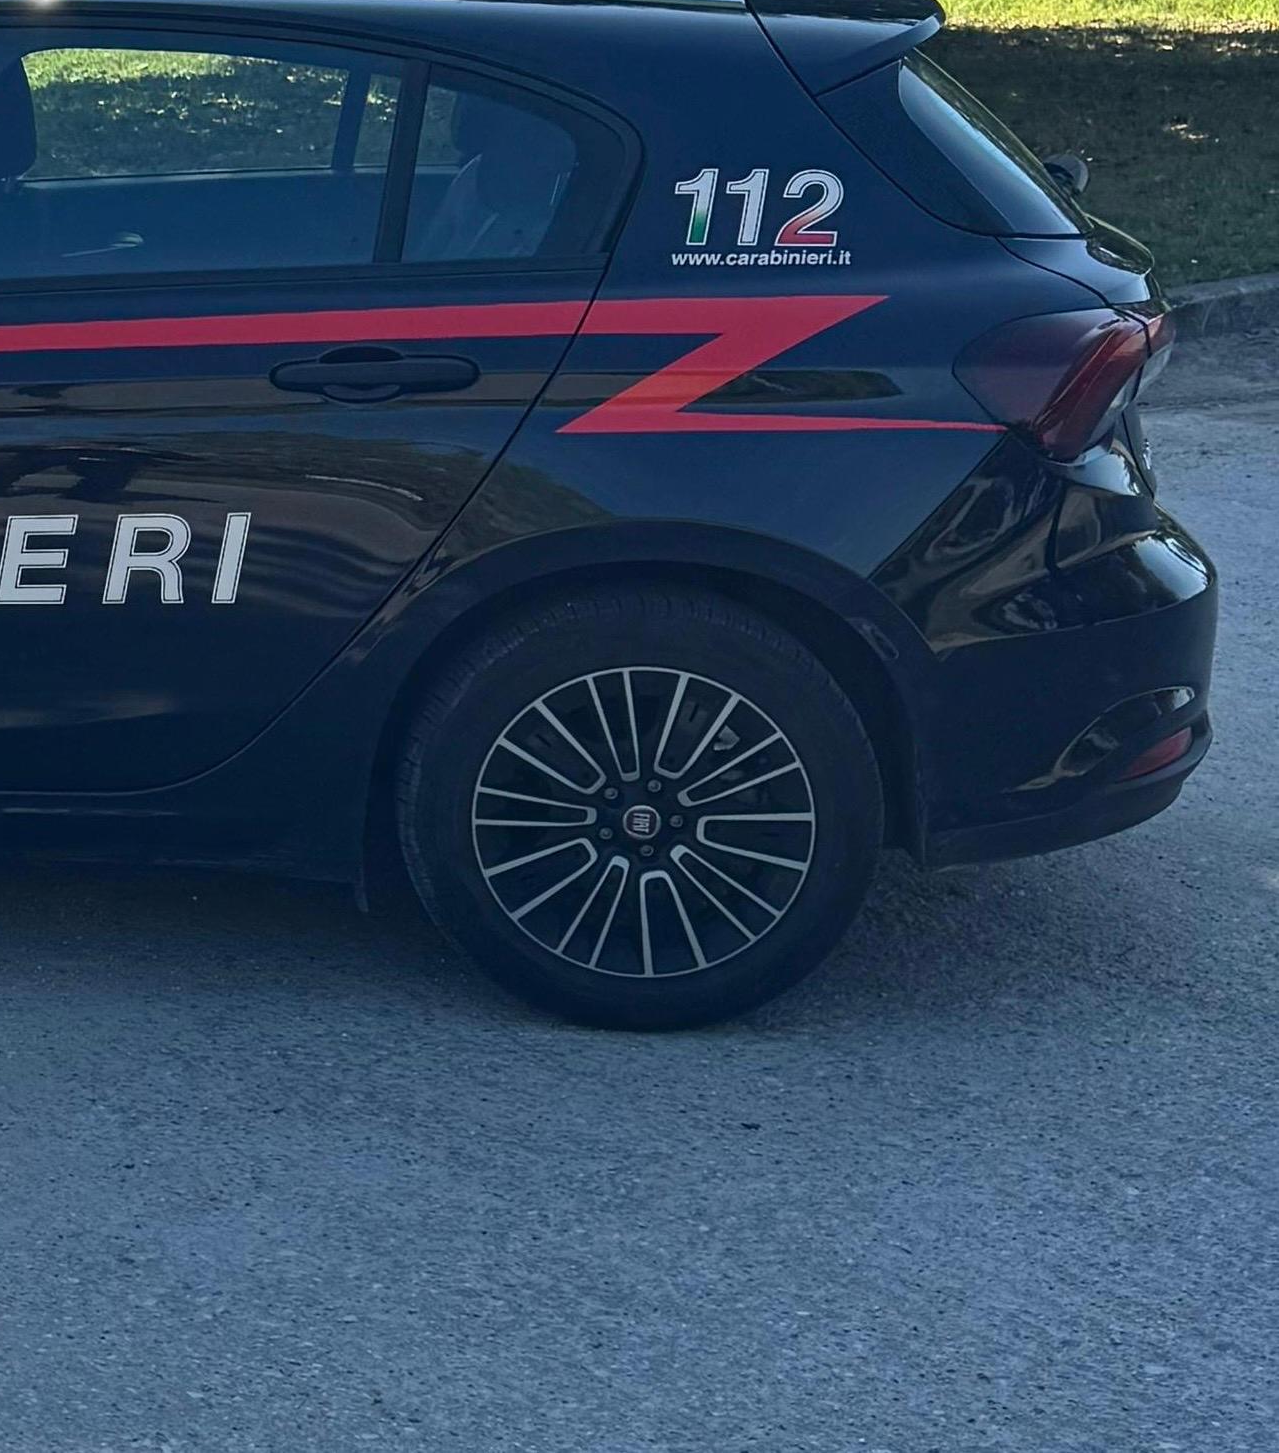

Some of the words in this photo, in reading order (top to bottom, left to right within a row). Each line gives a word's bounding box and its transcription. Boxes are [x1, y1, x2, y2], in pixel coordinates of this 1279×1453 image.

[674, 168, 844, 247] 112
[671, 249, 852, 266] www.carabinieri.it
[633, 812, 650, 834] FIAT
